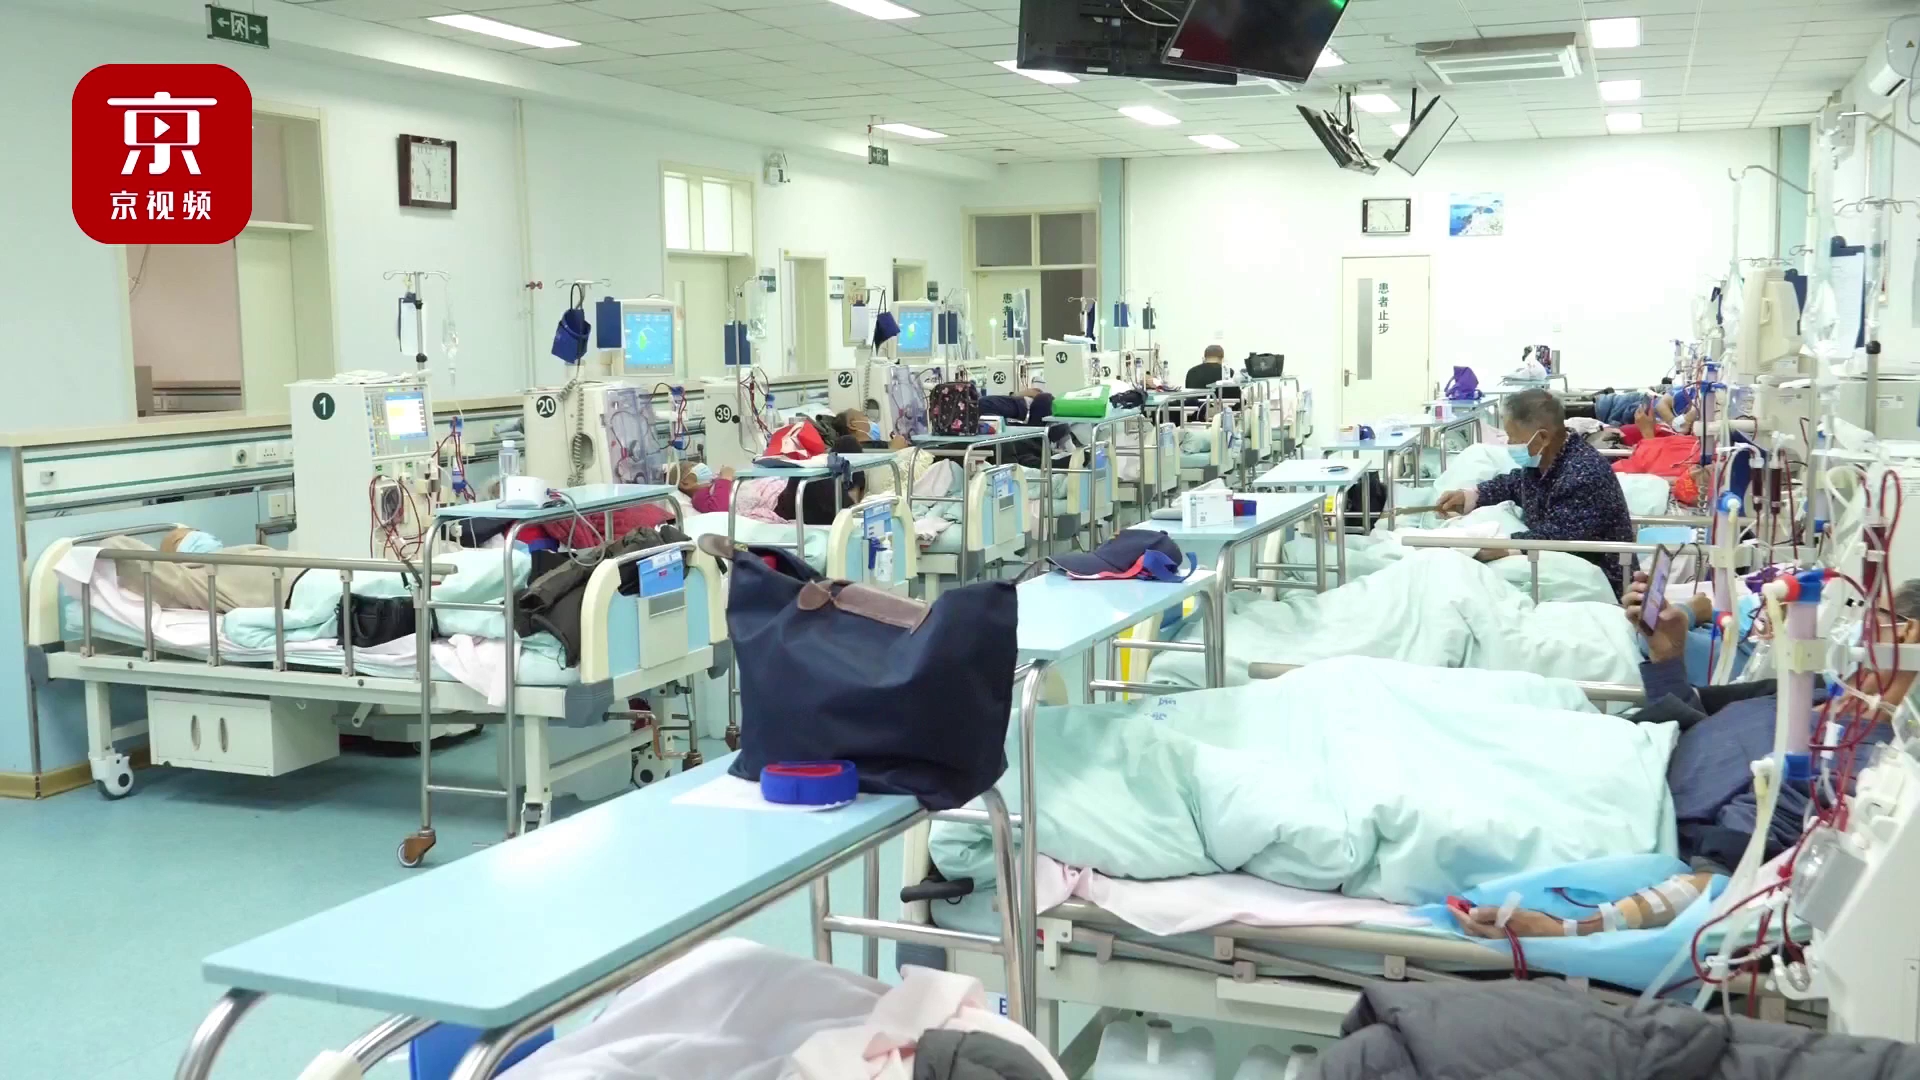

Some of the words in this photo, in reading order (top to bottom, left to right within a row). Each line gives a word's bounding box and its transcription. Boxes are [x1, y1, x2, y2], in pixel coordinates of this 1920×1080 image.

[1378, 283, 1390, 335] 患者止步
[1056, 352, 1066, 362] 14
[840, 373, 852, 386] 22
[994, 372, 1005, 383] 28
[319, 397, 327, 416] 1
[538, 398, 555, 415] 20
[716, 407, 731, 421] 39
